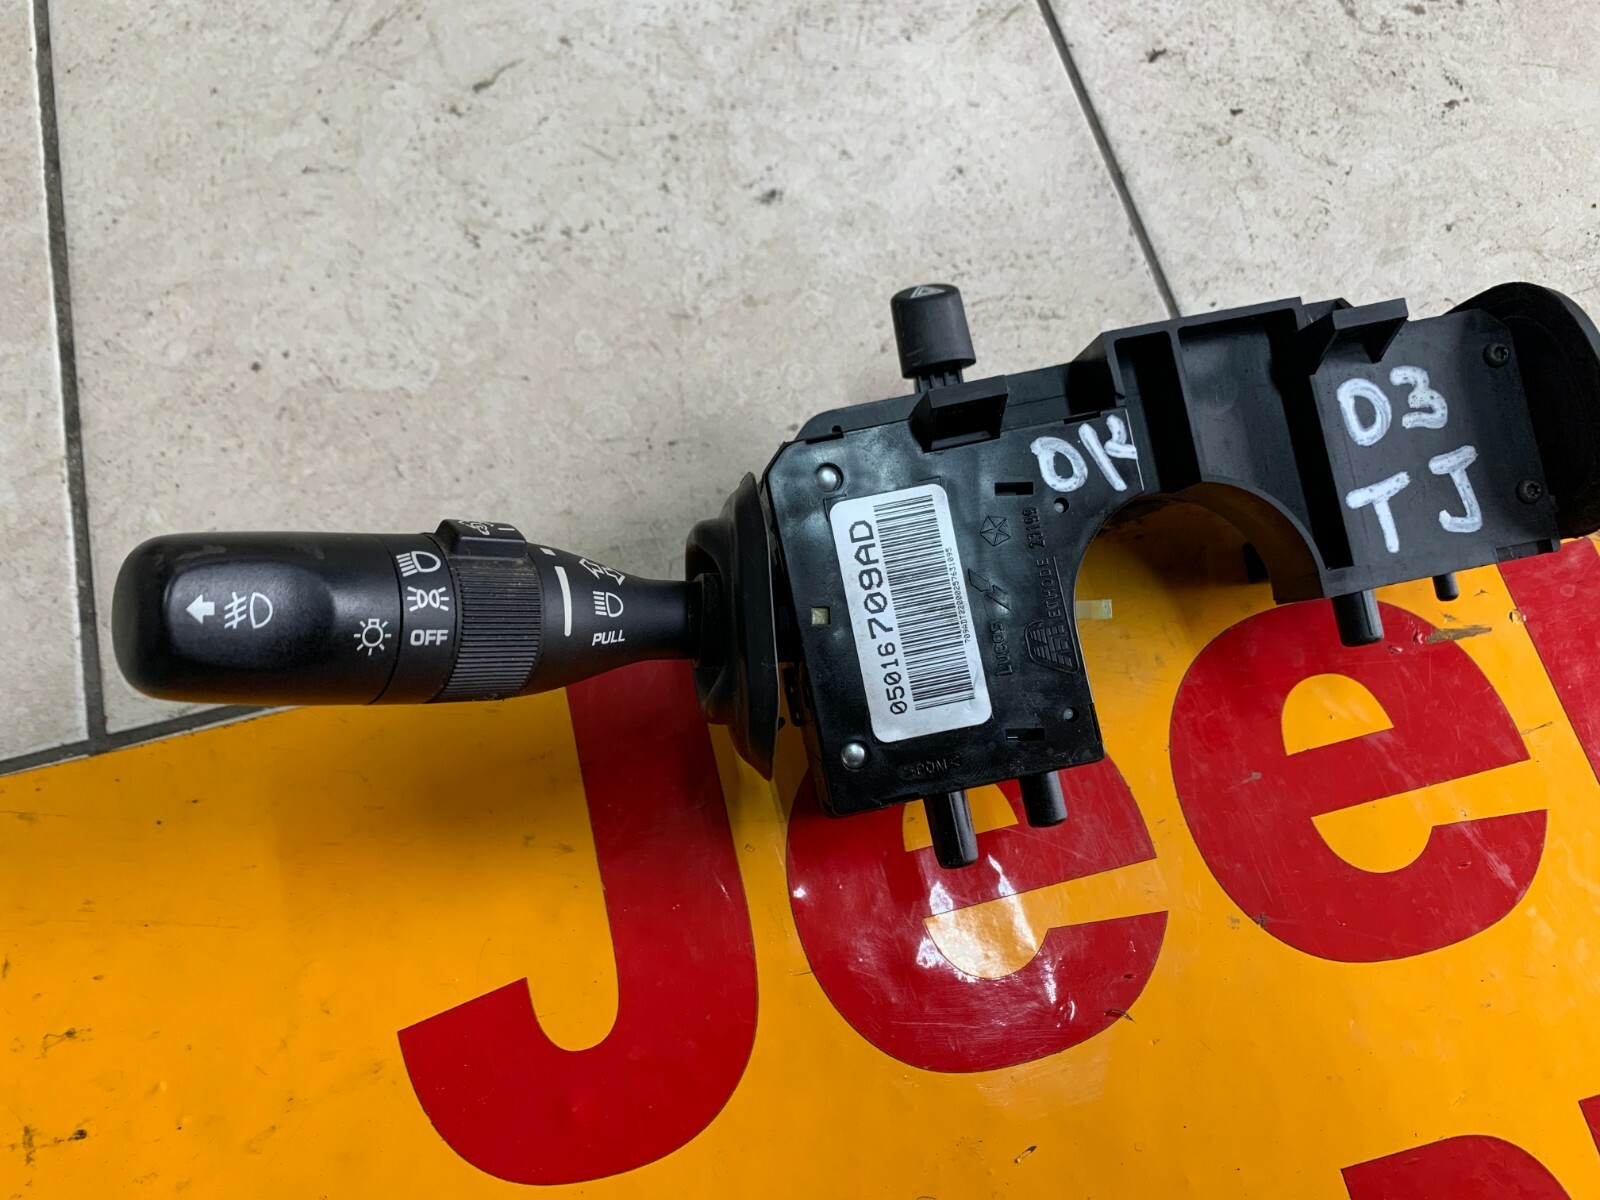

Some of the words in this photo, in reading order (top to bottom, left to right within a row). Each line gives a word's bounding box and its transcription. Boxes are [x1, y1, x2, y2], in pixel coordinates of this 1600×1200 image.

[1336, 365, 1449, 447] 03
[1029, 413, 1138, 493] OK
[410, 629, 449, 646] OFF
[592, 629, 626, 646] PULL
[397, 537, 1600, 1186] Jee
